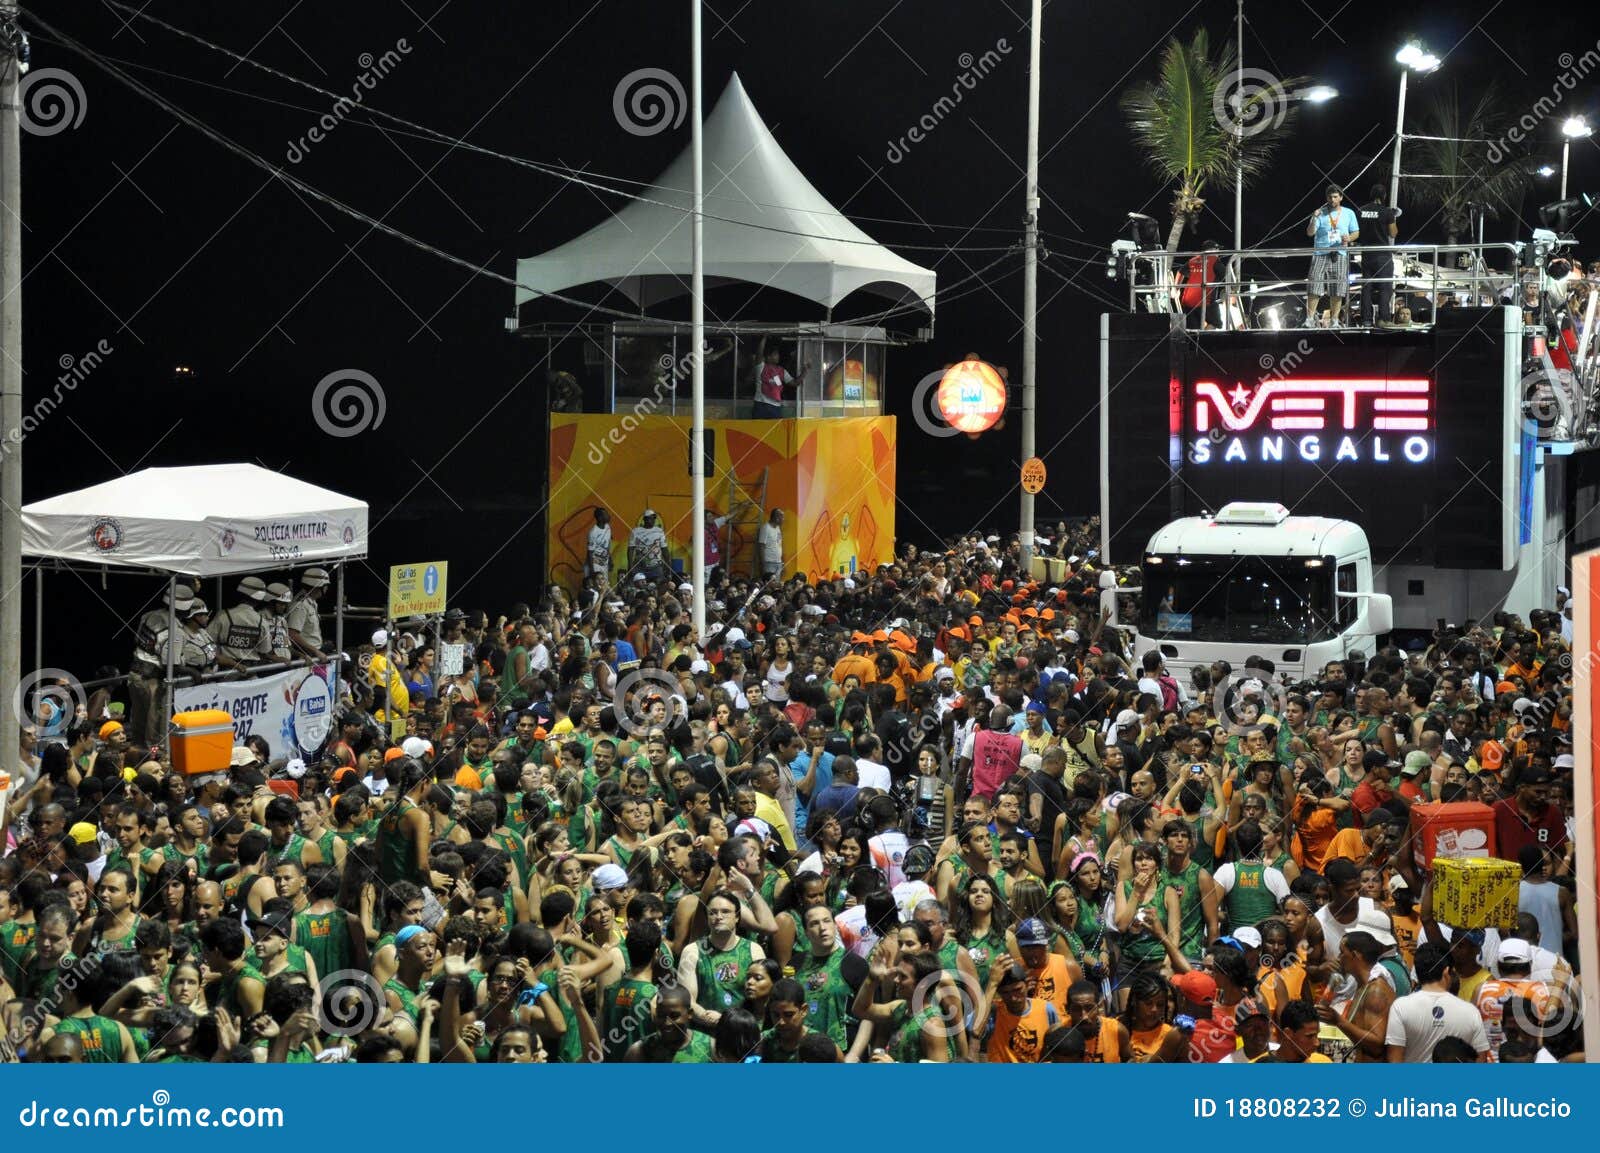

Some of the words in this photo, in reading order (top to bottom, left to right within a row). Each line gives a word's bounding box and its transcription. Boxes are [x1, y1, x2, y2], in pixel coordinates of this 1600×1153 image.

[1194, 436, 1429, 462] SANGALO
[254, 523, 290, 542] POLÍCIA
[292, 522, 328, 540] MILITAR
[232, 692, 269, 719] GENTE
[1538, 828, 1549, 842] 8
